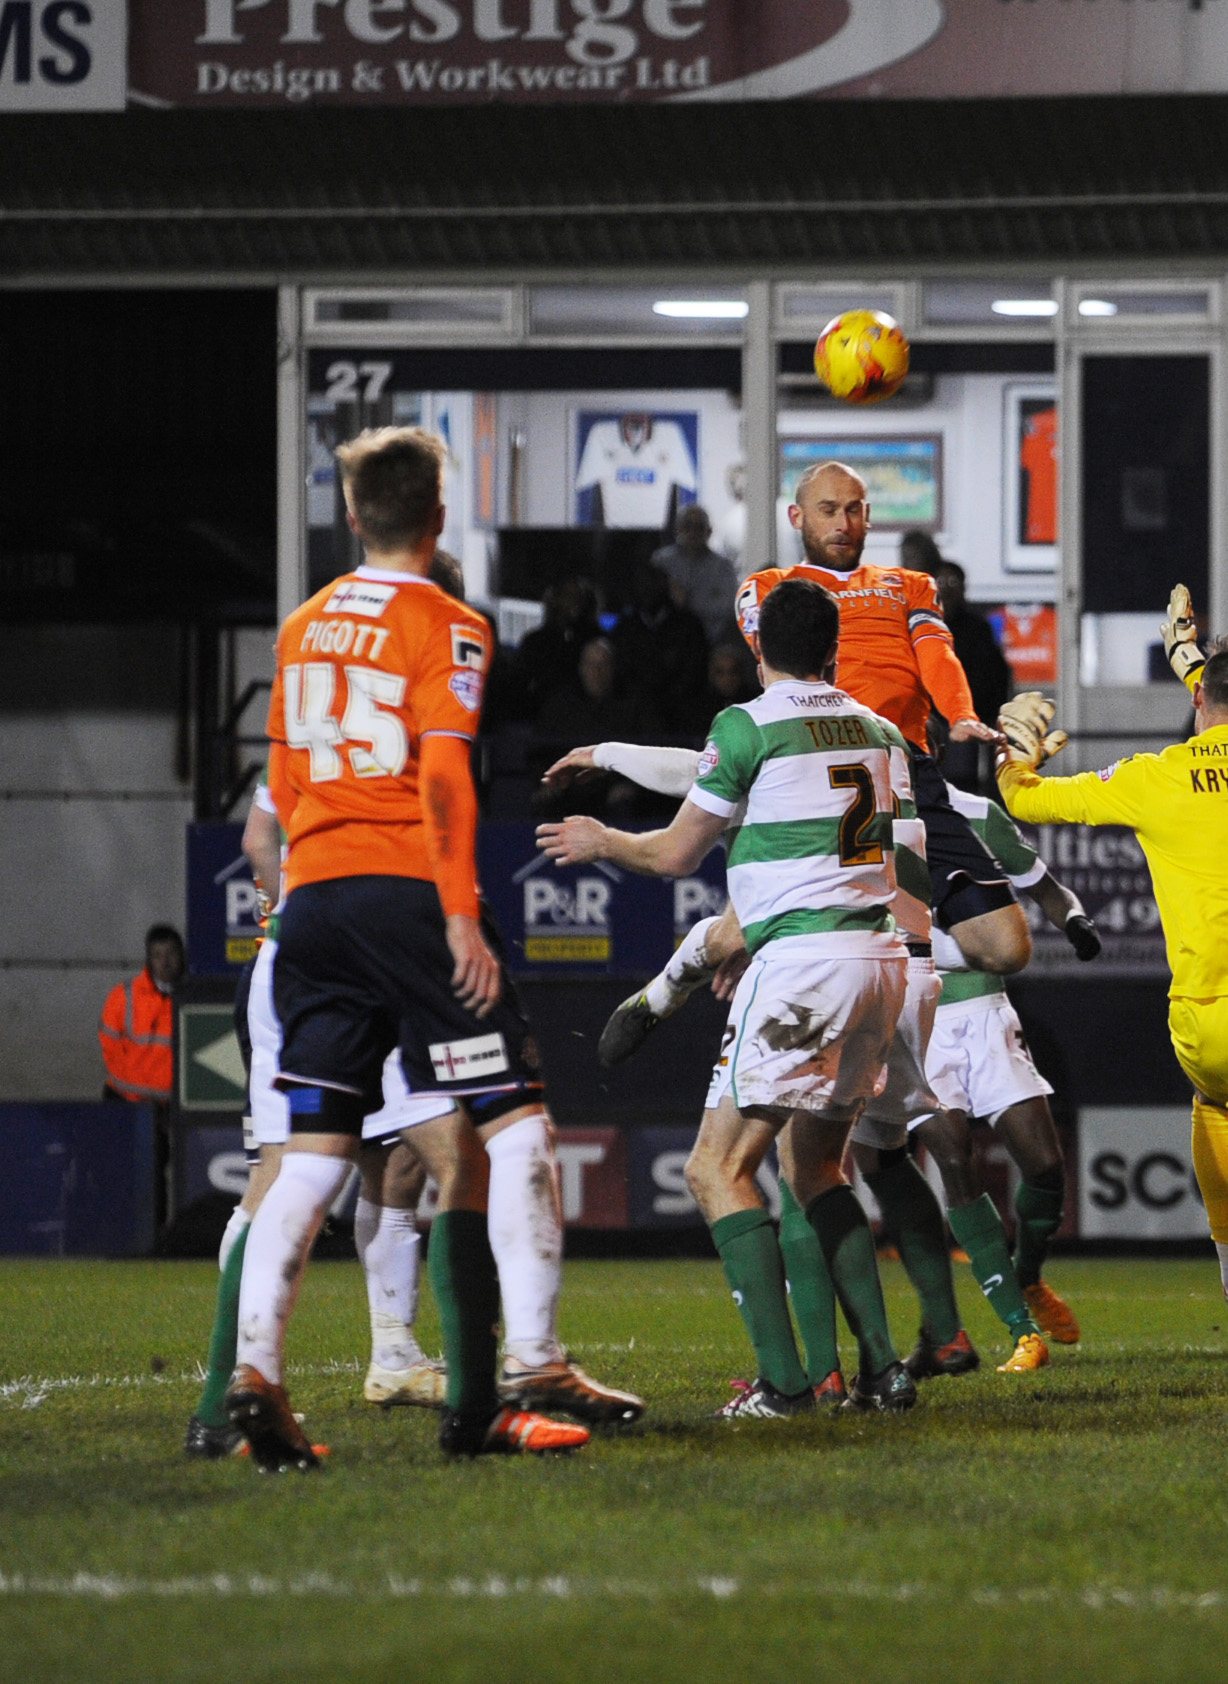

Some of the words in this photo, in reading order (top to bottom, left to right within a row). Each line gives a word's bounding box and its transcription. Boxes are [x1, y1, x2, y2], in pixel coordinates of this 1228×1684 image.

[198, 61, 342, 101] Design
[352, 61, 384, 92] &
[396, 59, 627, 91] Workwear
[636, 56, 711, 88] Ltd
[325, 361, 392, 402] 27
[829, 588, 907, 605] ARNFIELD
[300, 619, 391, 661] PIGOTT
[283, 661, 410, 783] 45
[805, 719, 869, 748] TOZER
[827, 763, 885, 868] 2
[524, 878, 611, 925] P&R
[674, 878, 724, 925] P&
